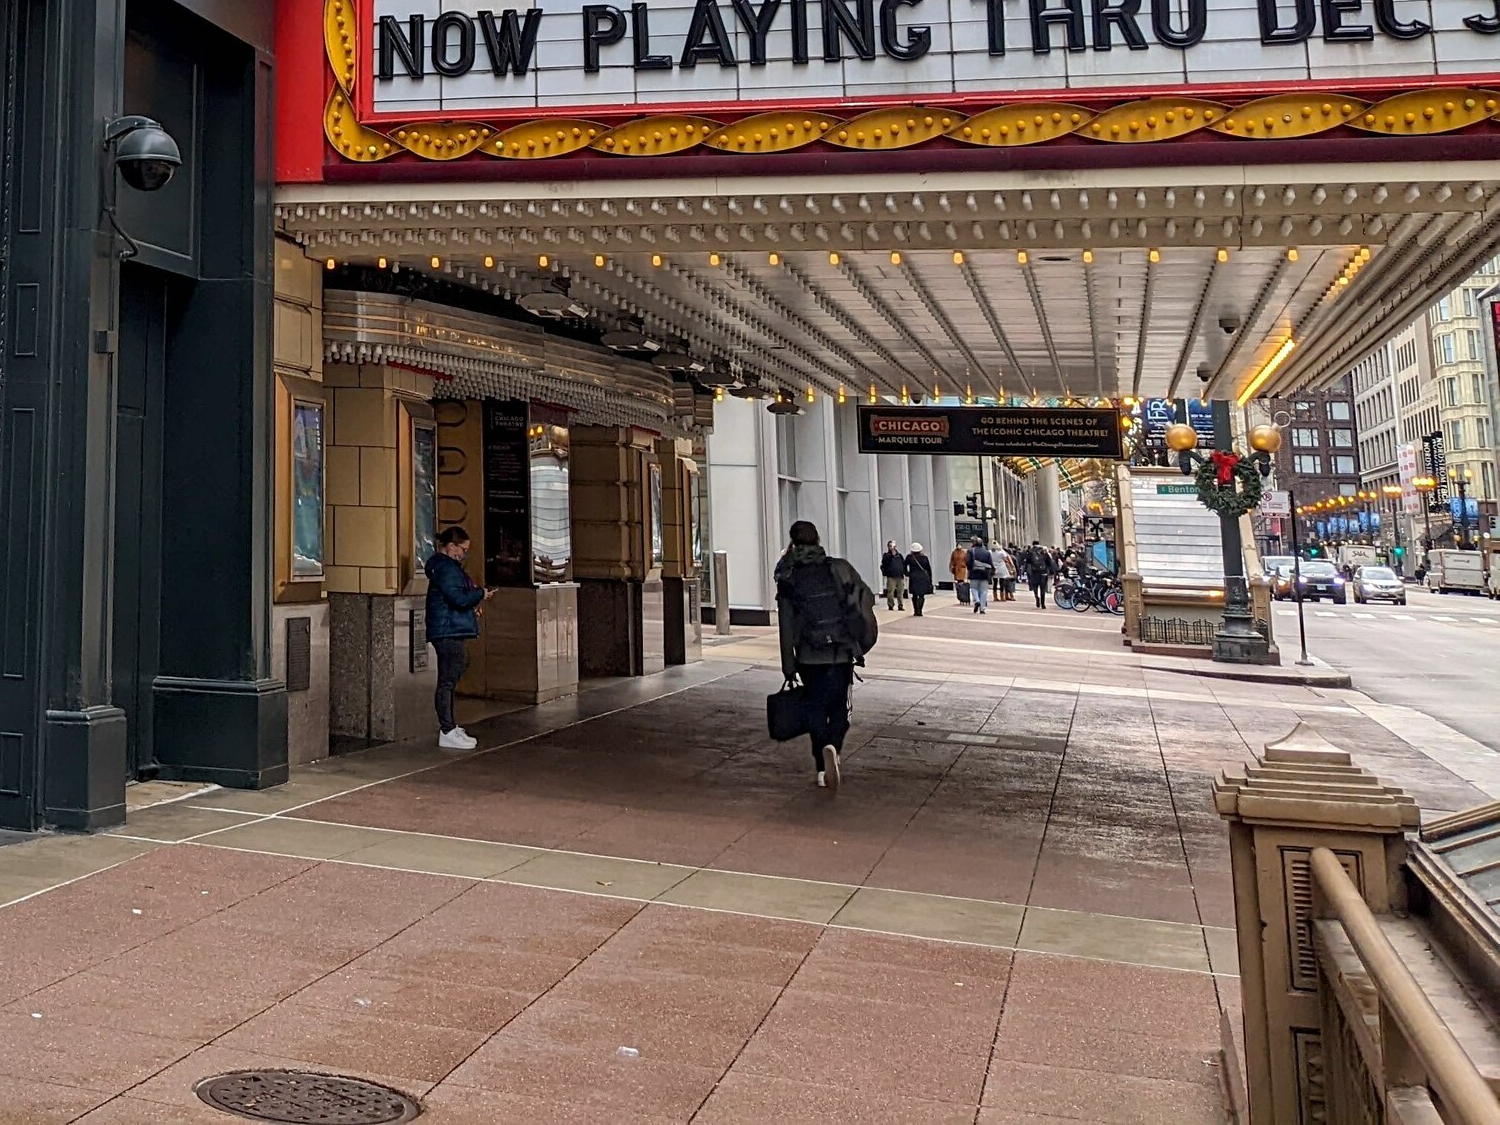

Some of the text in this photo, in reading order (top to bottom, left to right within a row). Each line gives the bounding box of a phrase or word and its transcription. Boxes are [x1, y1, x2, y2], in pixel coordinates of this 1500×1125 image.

[378, 7, 544, 80] NOW
[878, 421, 941, 431] CHICAGO
[996, 417, 1030, 425] BEHIND
[1050, 418, 1084, 426] SCENES
[1085, 418, 1098, 426] OF
[972, 427, 989, 435] THE
[1024, 428, 1065, 436] CHICAGO
[878, 436, 919, 445] MARQUEE
[1437, 437, 1448, 482] NORDSTROM
[1168, 485, 1201, 493] Benton
